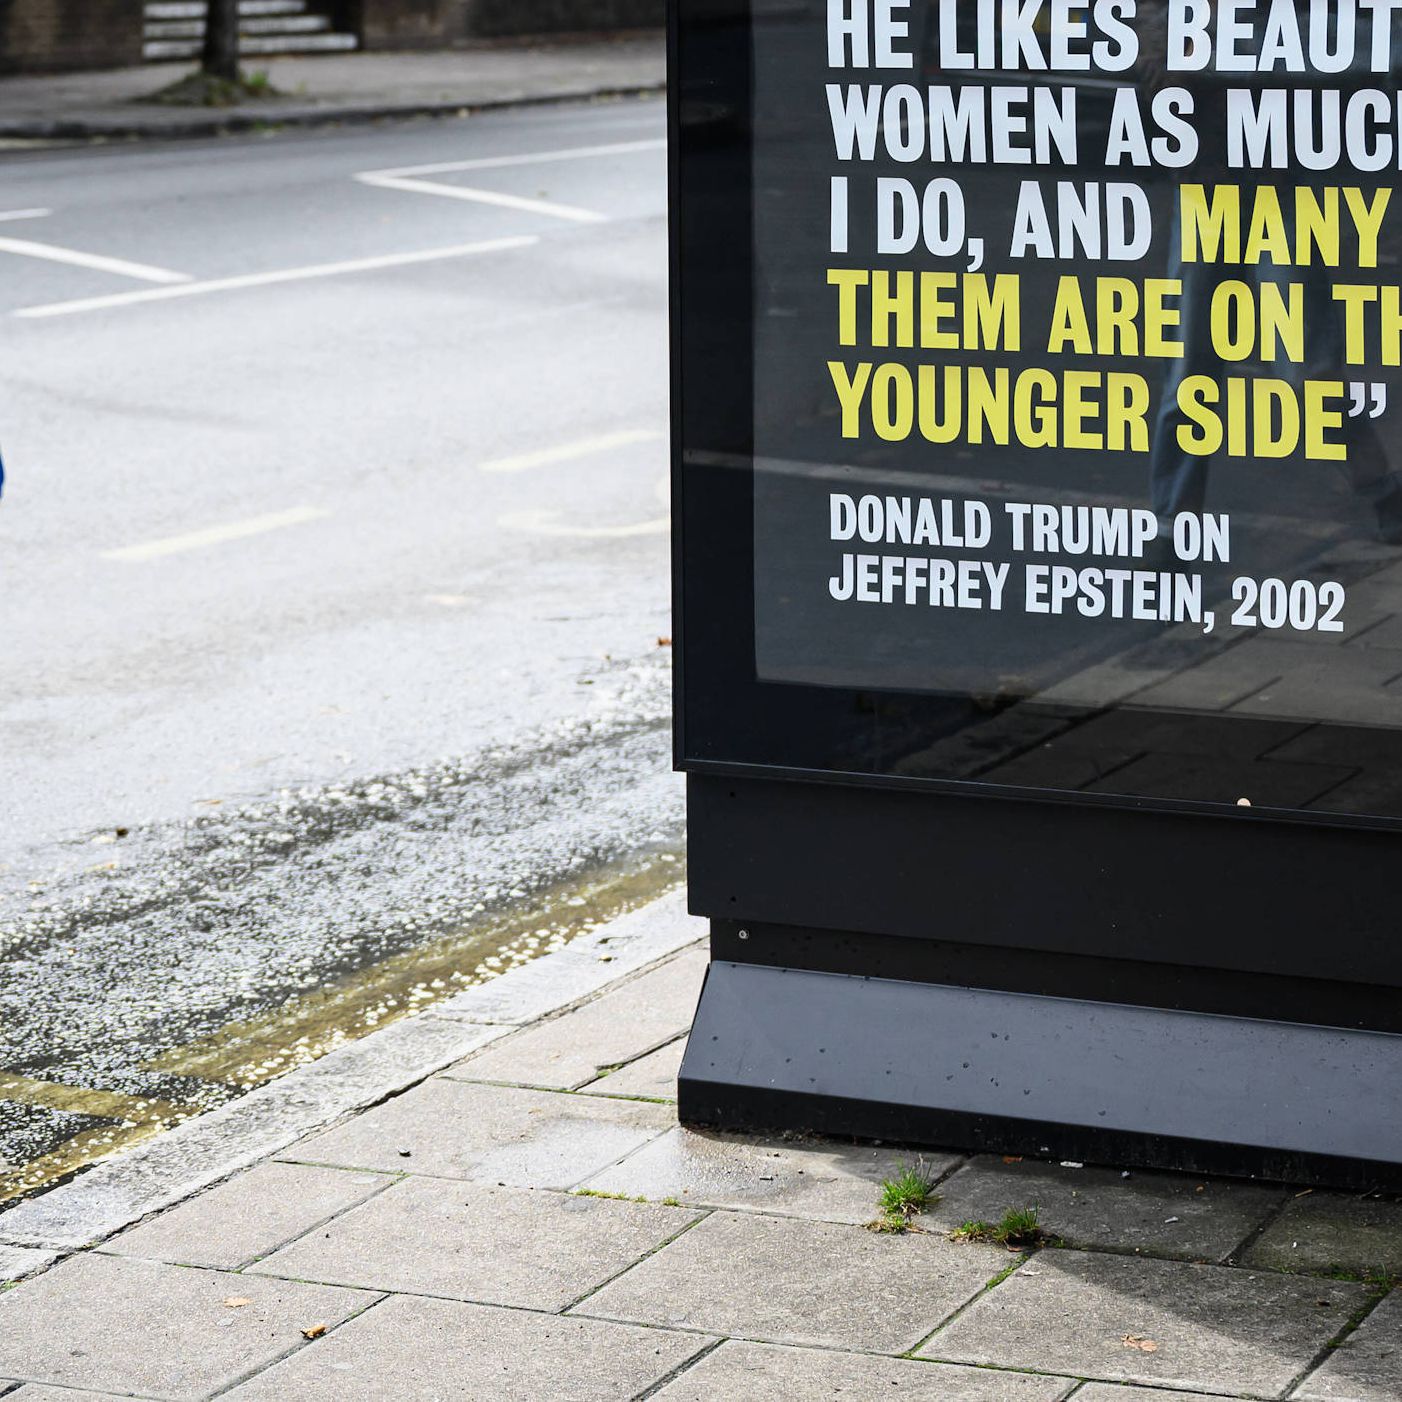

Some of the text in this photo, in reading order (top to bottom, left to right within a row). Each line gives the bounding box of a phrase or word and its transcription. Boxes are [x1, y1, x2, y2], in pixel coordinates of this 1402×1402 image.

[826, 84, 1077, 164] WOMEN
[1105, 87, 1198, 167] AS
[831, 177, 847, 252] I
[877, 178, 983, 272] DO,
[1010, 181, 1151, 260] AND
[1180, 184, 1392, 267] MANY
[827, 269, 1020, 351] THEM
[1047, 276, 1184, 358] ARE
[1211, 280, 1303, 362] ON
[827, 361, 1149, 452] YOUNGER
[830, 494, 1229, 562] DONALD TRUMP ON
[829, 554, 1345, 633] JEFFREY EPSTEIN, 2002
